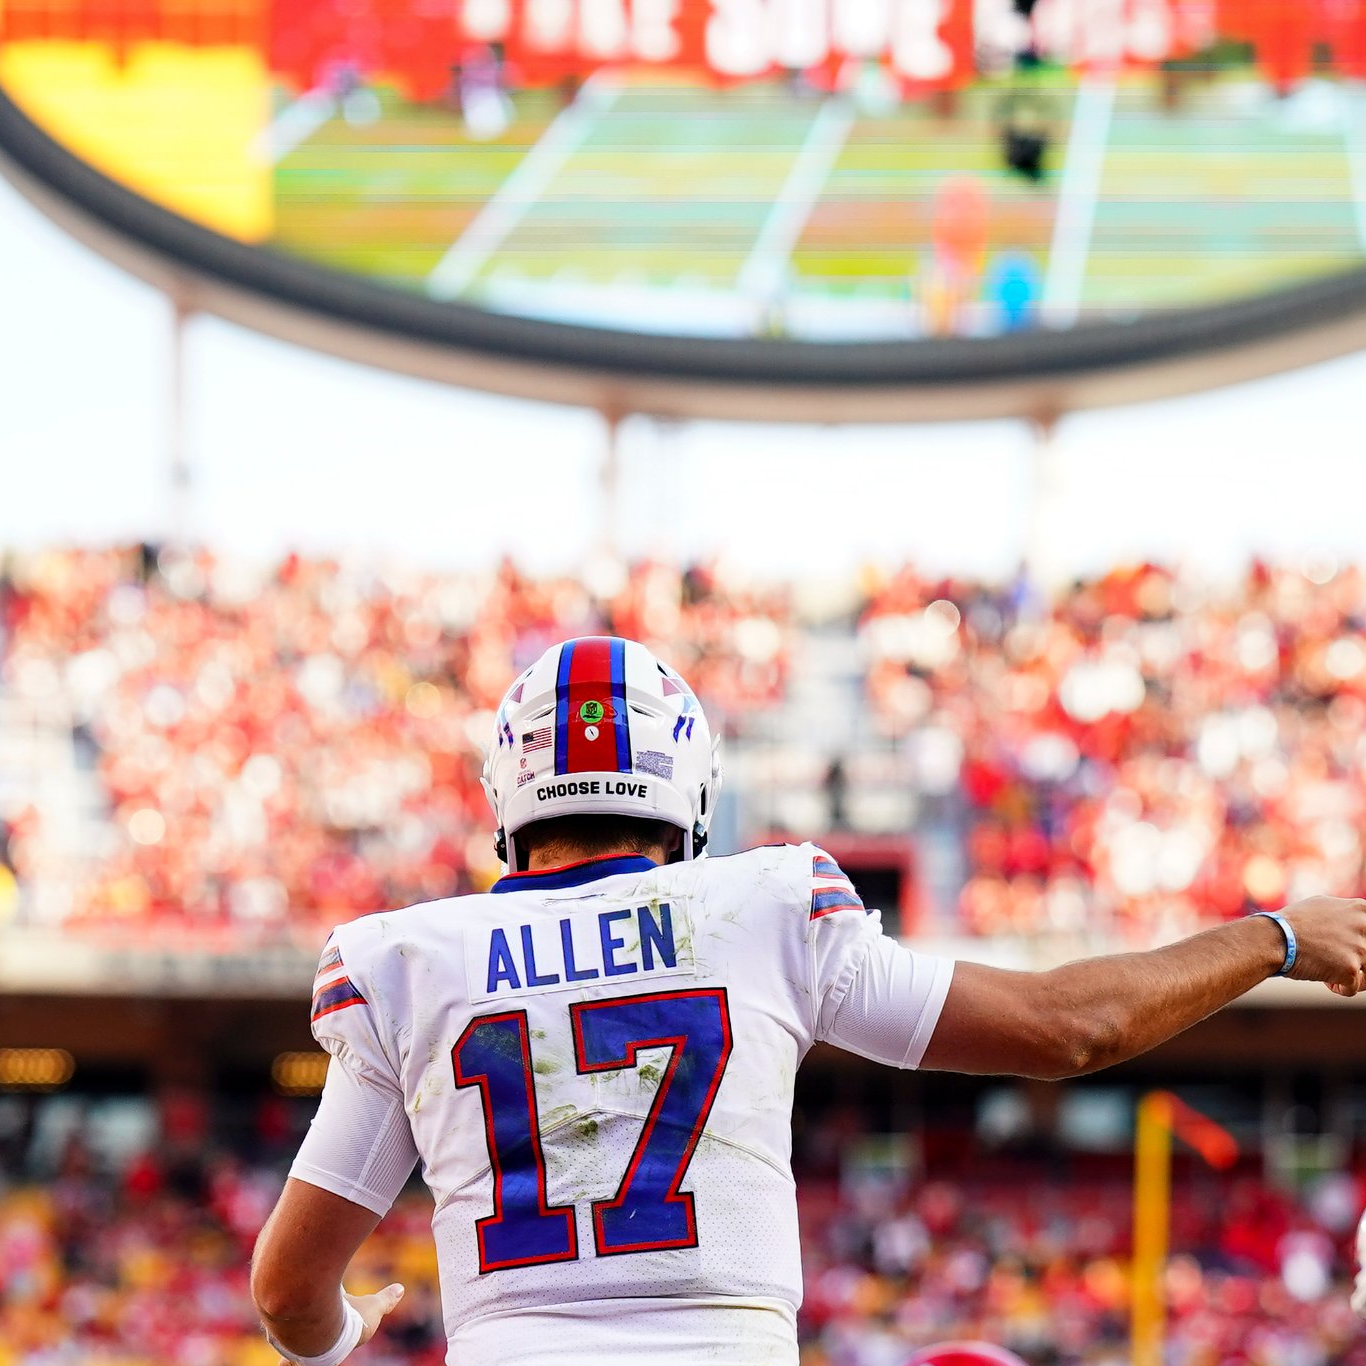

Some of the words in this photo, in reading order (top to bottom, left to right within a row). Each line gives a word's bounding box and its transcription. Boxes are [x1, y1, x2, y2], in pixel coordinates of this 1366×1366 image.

[537, 781, 600, 801] CHOOSE
[605, 781, 648, 799] LOVE
[486, 902, 677, 994] ALLEN
[451, 986, 734, 1276] 17
